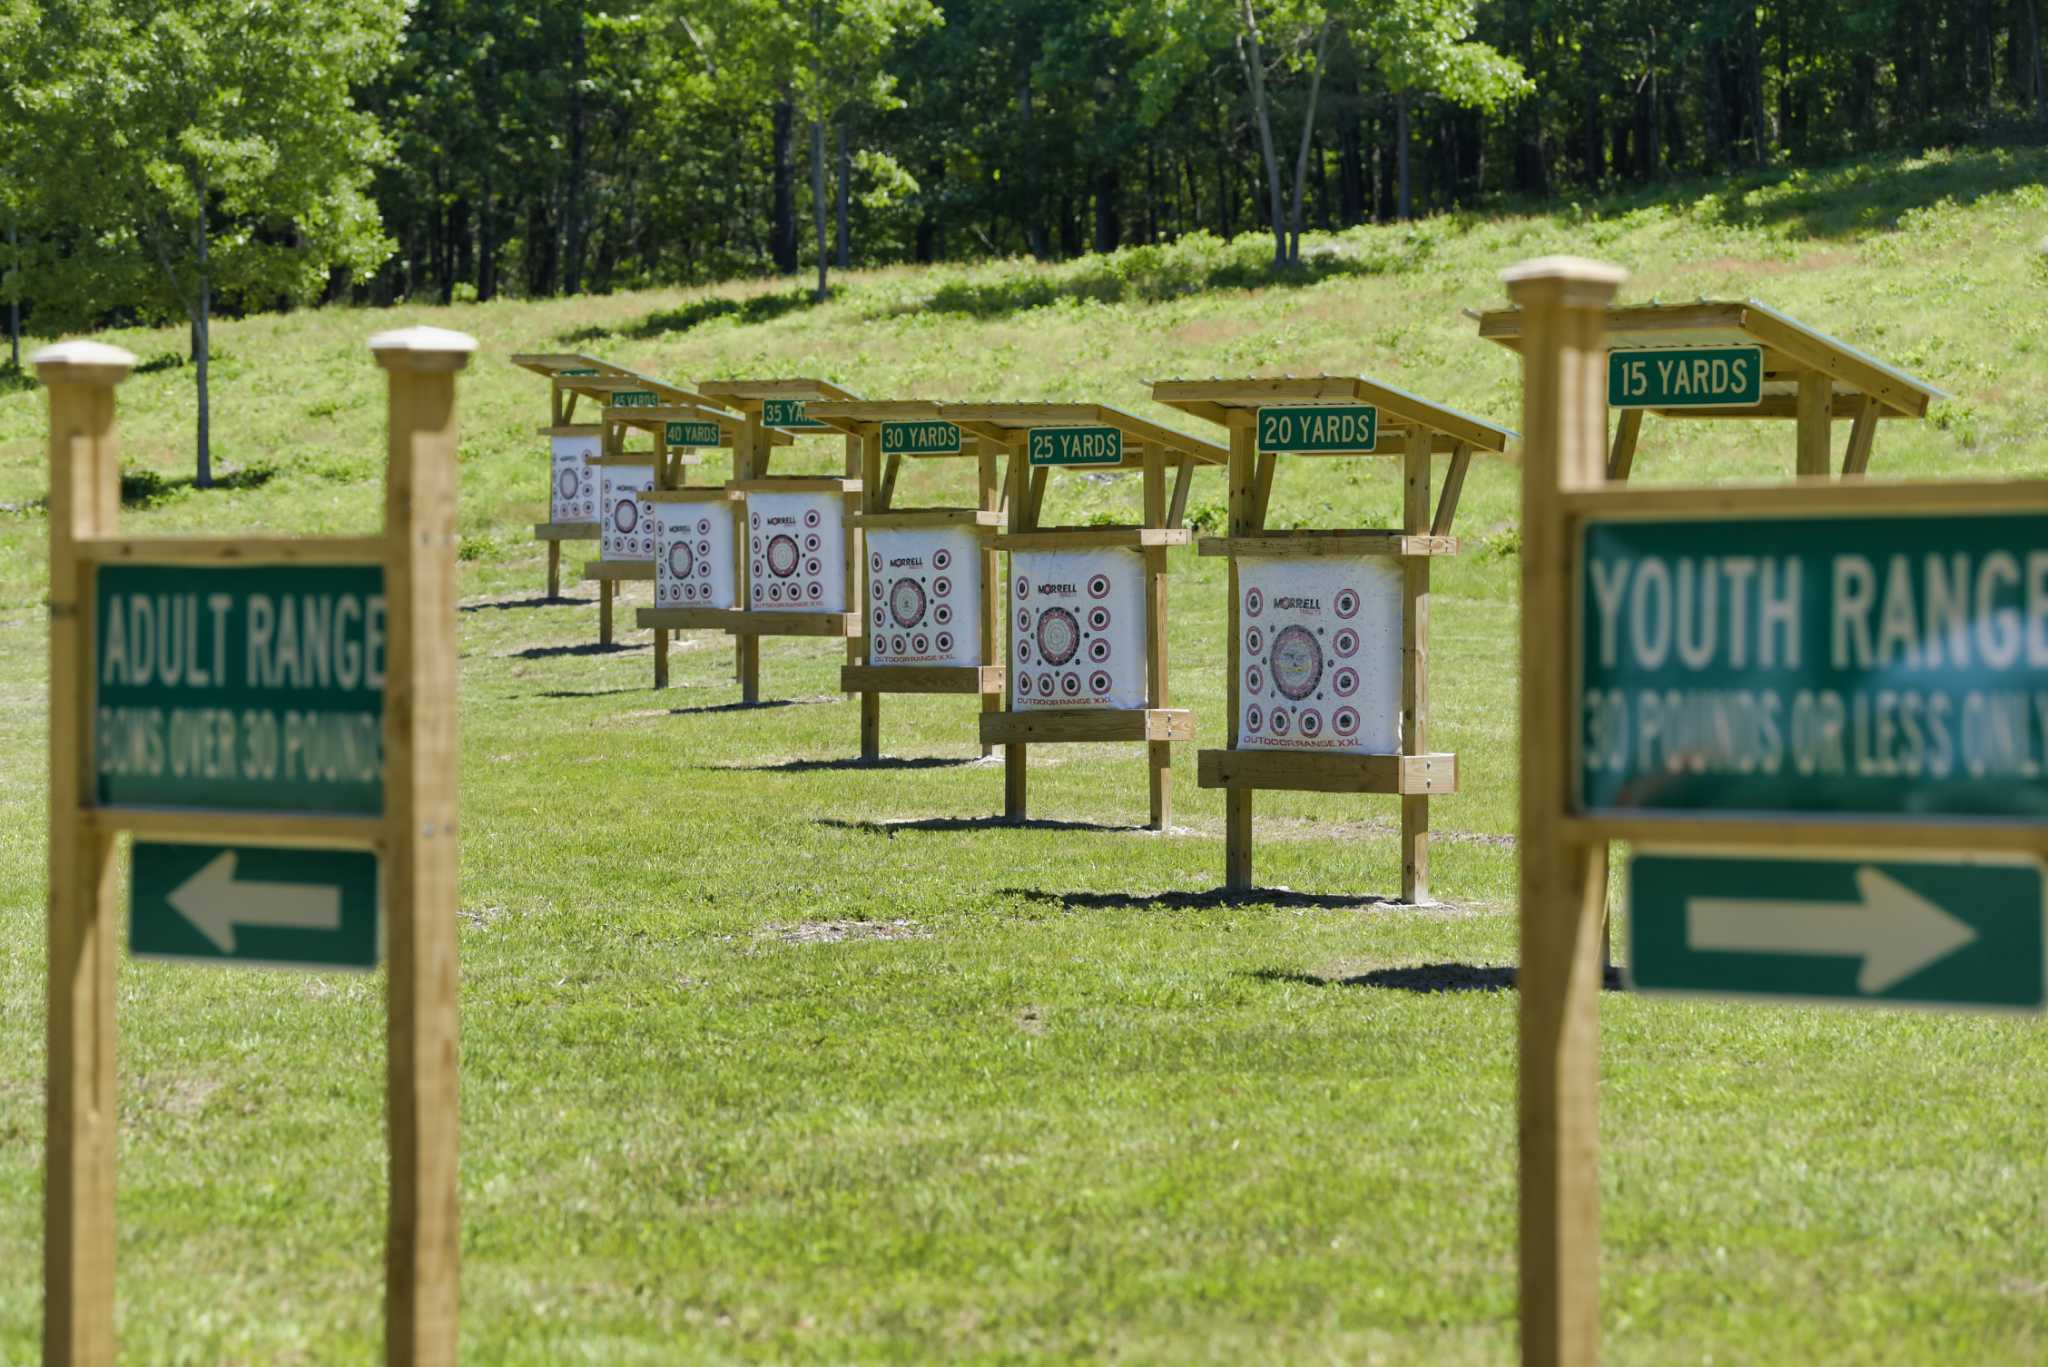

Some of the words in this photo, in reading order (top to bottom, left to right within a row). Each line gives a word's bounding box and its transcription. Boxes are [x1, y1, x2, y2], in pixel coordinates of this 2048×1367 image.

[1621, 360, 1648, 397] 15
[1657, 358, 1748, 396] YARDS
[765, 404, 782, 422] 35
[669, 425, 682, 441] 40
[684, 425, 716, 441] YARDS
[885, 428, 904, 449] 30
[909, 427, 957, 447] YARDS
[1264, 415, 1292, 445] 20
[1299, 413, 1370, 444] YARDS
[1034, 436, 1054, 459] 25
[1060, 434, 1117, 458] YARDS
[889, 556, 923, 568] MORRELL
[1038, 584, 1077, 595] MORRELL
[1274, 596, 1321, 610] MORRELL
[1590, 556, 1803, 671] YOUTH
[1831, 551, 2048, 671] RANGE
[102, 593, 234, 687] ADULT
[246, 593, 387, 690] RANGE
[242, 708, 279, 779] 30
[1791, 689, 1847, 776] OR
[1854, 689, 1952, 778] LESS
